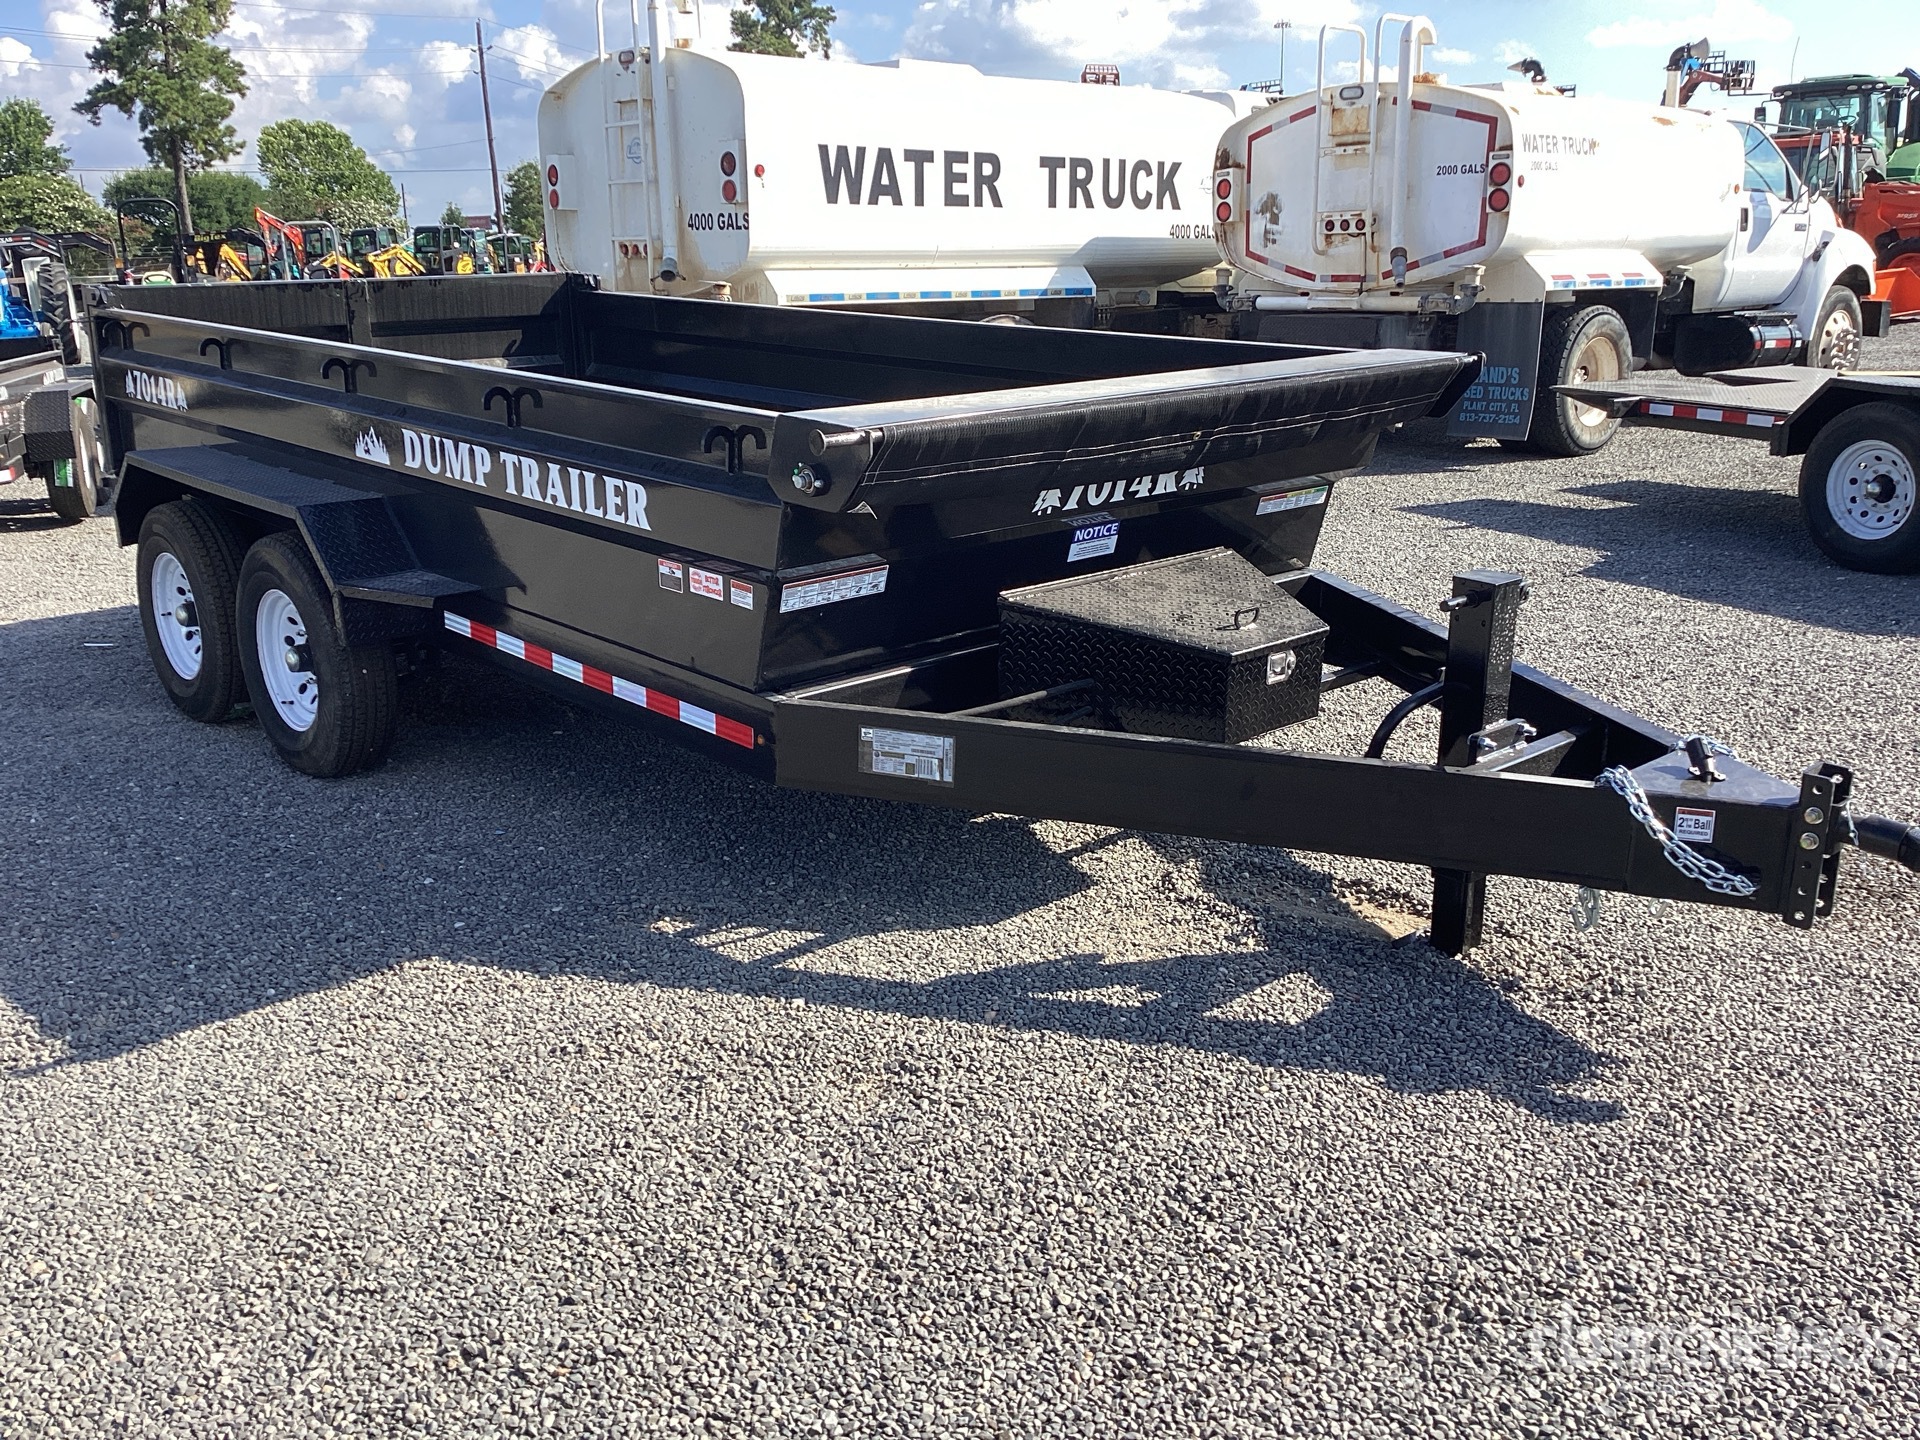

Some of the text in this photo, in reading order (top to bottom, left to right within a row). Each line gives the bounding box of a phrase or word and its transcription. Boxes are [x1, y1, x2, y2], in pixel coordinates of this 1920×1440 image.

[1521, 133, 1596, 155] WATER TRUCK
[818, 143, 1183, 211] WATER TRUCK
[1436, 163, 1486, 176] 2000 GALS
[687, 212, 750, 231] 4000 GALS
[1169, 224, 1216, 239] 4000 GAL
[133, 370, 179, 411] 7014R
[1488, 386, 1529, 400] TRUCKS
[1463, 401, 1519, 413] PLANT CITY, FL
[1460, 413, 1520, 424] 813-737-2154
[401, 428, 653, 532] DUMP TRAILER
[1074, 522, 1119, 542] NOTICE
[1678, 817, 1685, 828] 2
[1694, 819, 1711, 830] Ball
